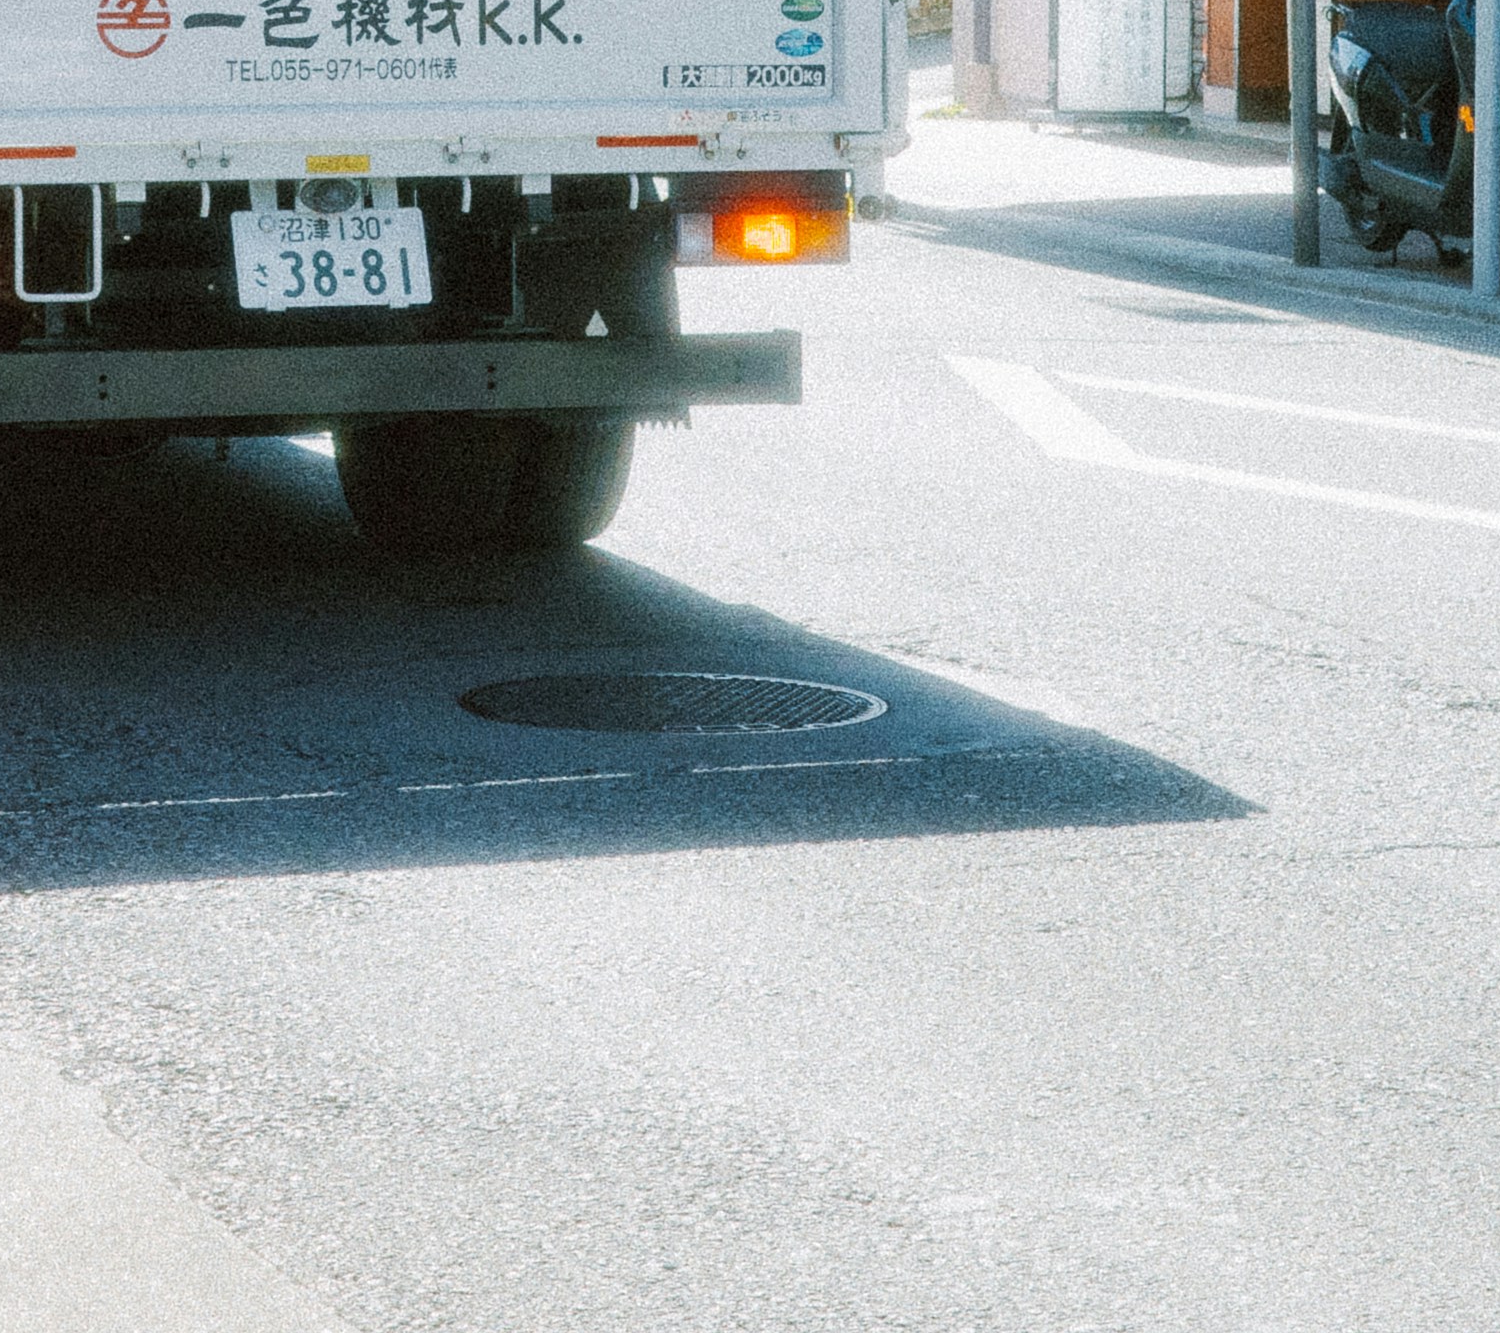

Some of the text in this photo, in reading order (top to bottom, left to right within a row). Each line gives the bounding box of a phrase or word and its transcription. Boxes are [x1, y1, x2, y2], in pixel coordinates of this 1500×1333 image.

[279, 216, 382, 243] 沼津 130
[253, 246, 412, 299] さ 38-81
